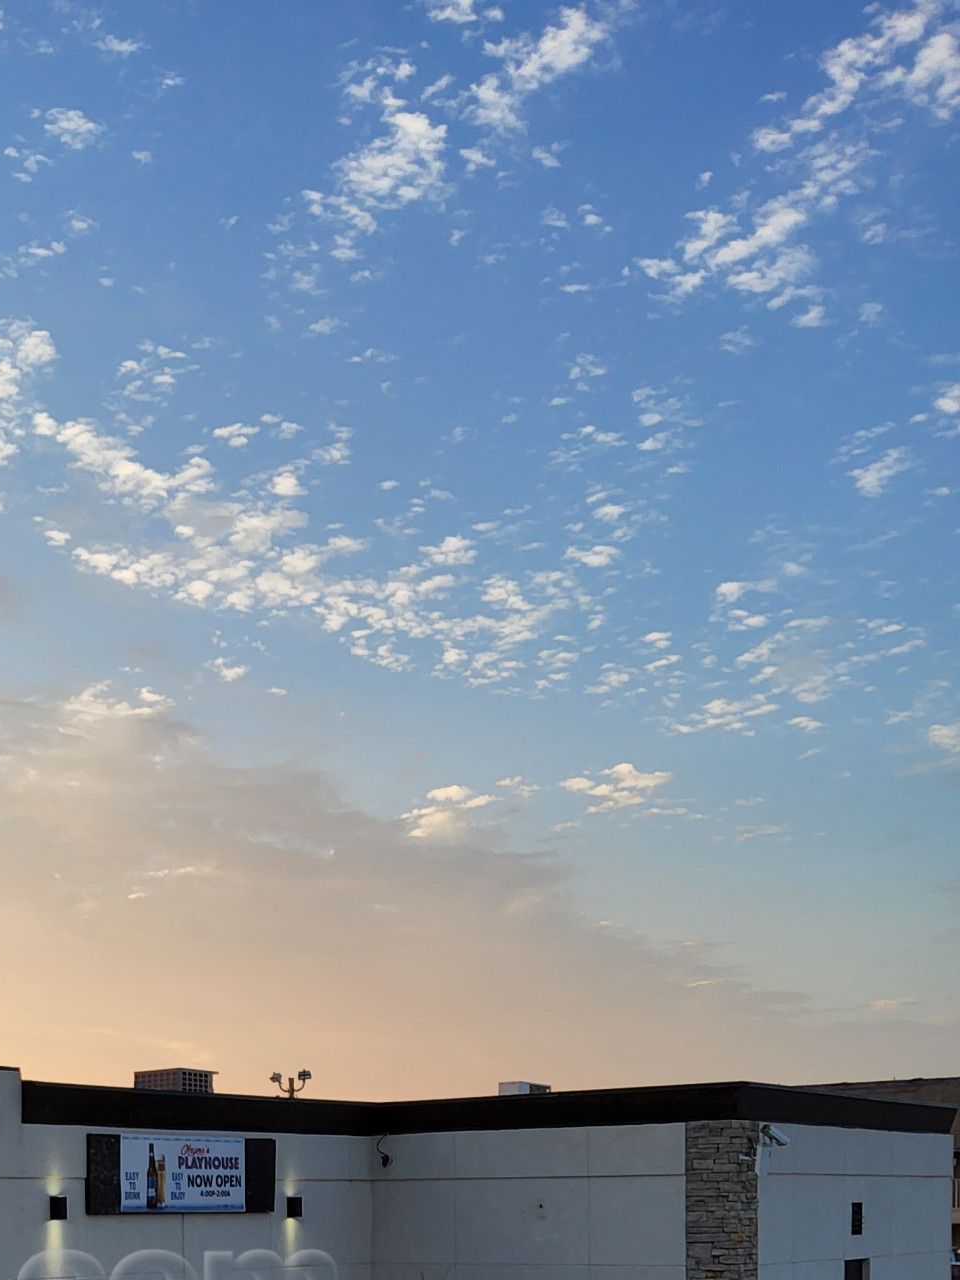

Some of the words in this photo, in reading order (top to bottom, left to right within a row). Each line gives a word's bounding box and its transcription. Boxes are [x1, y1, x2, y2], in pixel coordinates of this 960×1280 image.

[177, 1156, 239, 1170] PLAYHOUSE
[125, 1171, 139, 1181] EASY
[171, 1172, 184, 1181] EASY
[187, 1174, 214, 1188] NOW
[215, 1174, 242, 1188] OPEN
[128, 1181, 137, 1191] TO
[175, 1182, 182, 1191] TO
